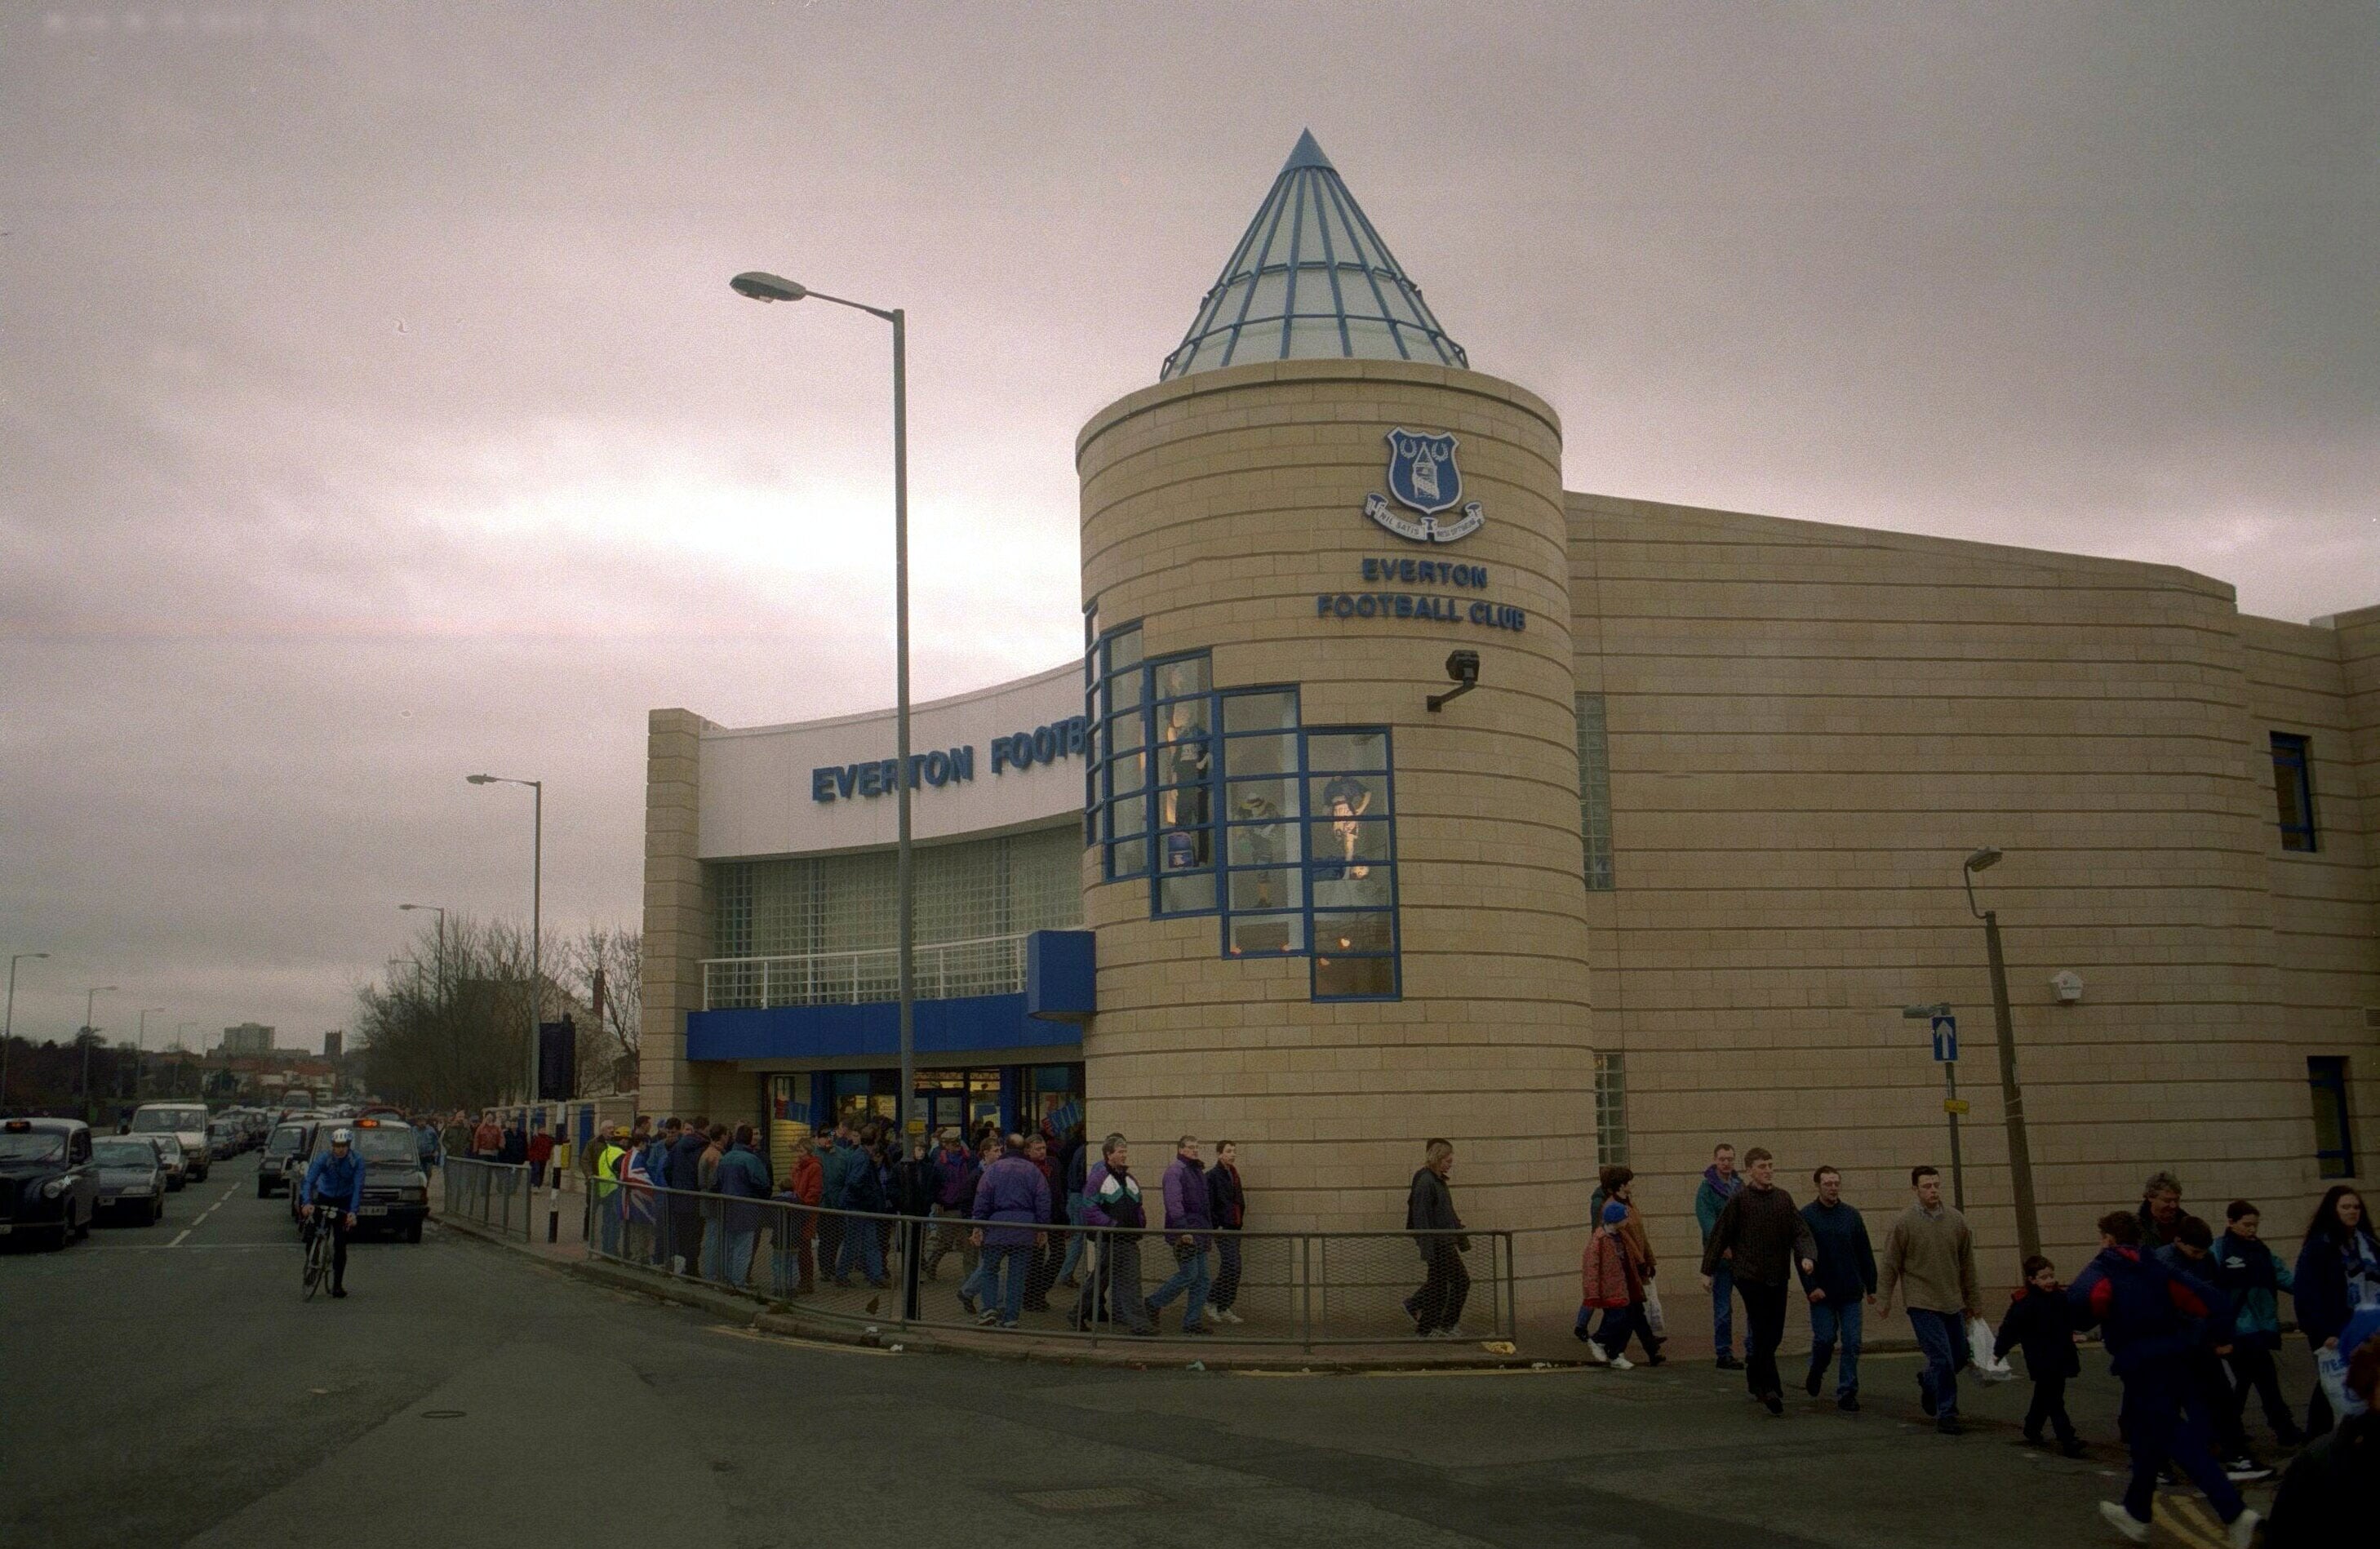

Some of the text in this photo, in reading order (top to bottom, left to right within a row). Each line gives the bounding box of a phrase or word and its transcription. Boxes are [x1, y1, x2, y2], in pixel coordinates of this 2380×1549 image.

[1379, 513, 1392, 525] NIL
[1396, 522, 1420, 535] SATIS
[1362, 558, 1487, 588] EVERTON
[1317, 593, 1525, 631] FOOTBALL CLUB
[812, 745, 974, 801] EVERTON
